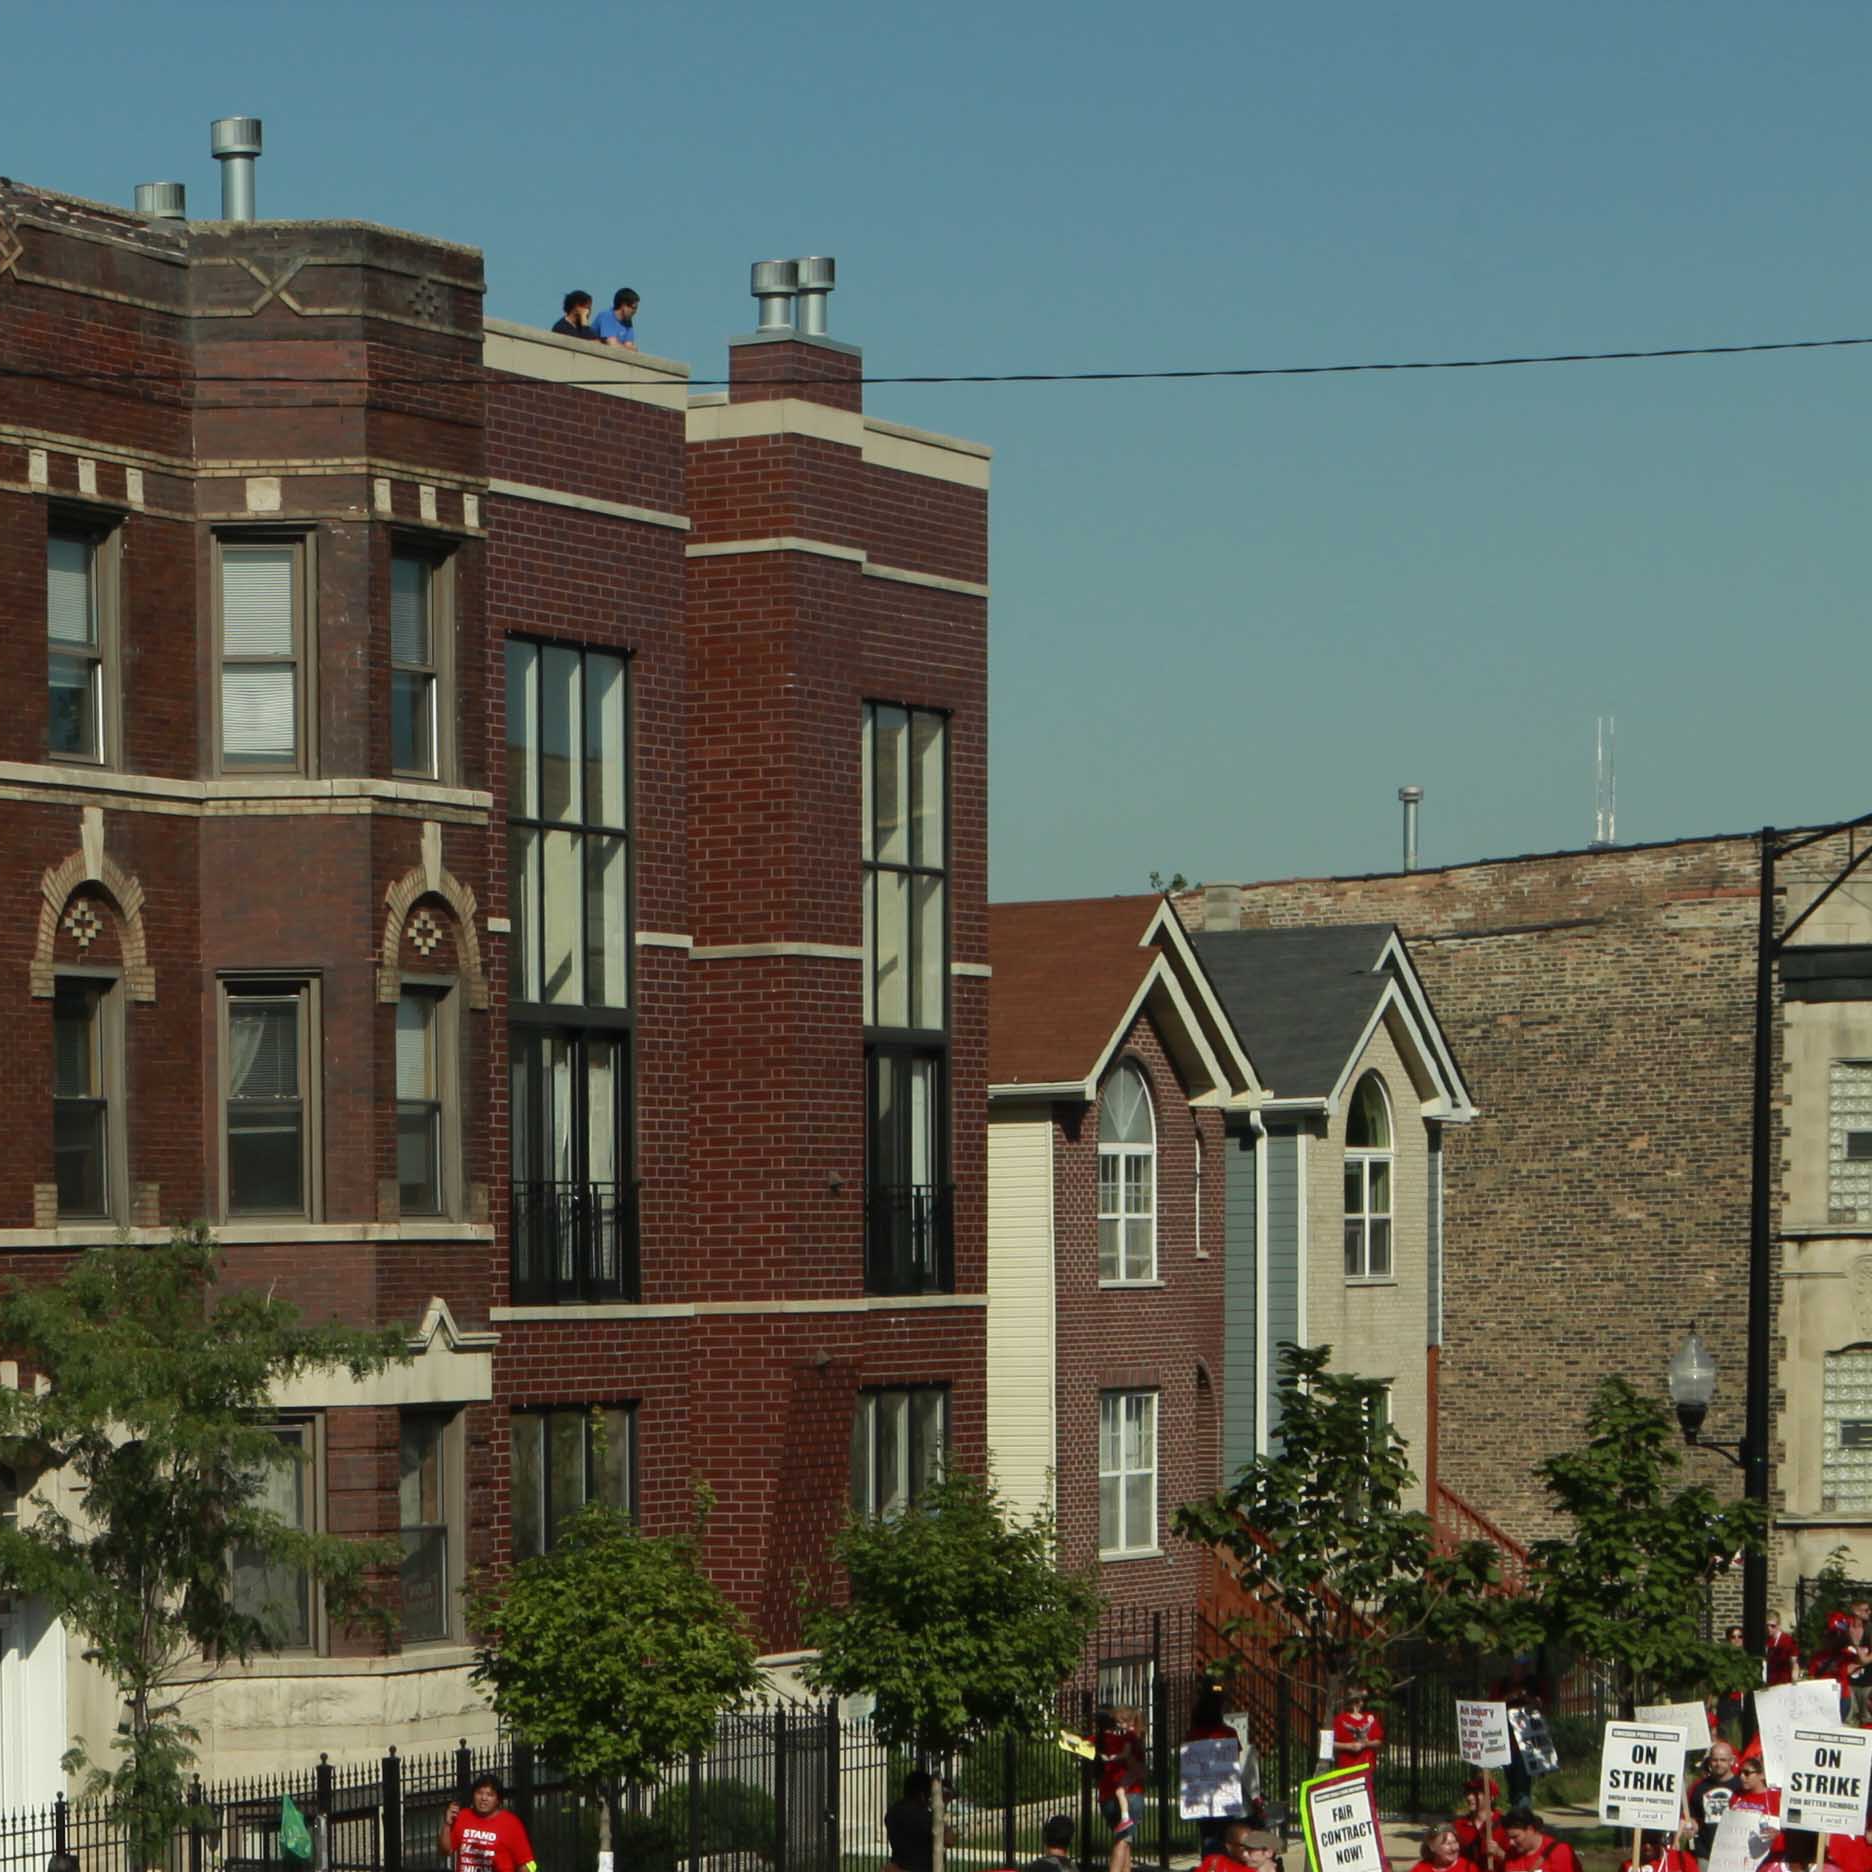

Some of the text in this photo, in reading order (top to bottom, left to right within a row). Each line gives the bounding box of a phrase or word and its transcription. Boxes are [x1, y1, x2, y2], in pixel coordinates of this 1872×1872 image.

[1632, 1744, 1657, 1765] ON
[1815, 1747, 1841, 1768] ON
[1609, 1770, 1676, 1793] STRIKE
[1790, 1773, 1860, 1797] STRIKE
[1332, 1803, 1354, 1825] FAIR
[1321, 1821, 1373, 1848] CONTRACT
[1335, 1846, 1364, 1865] NOW!
